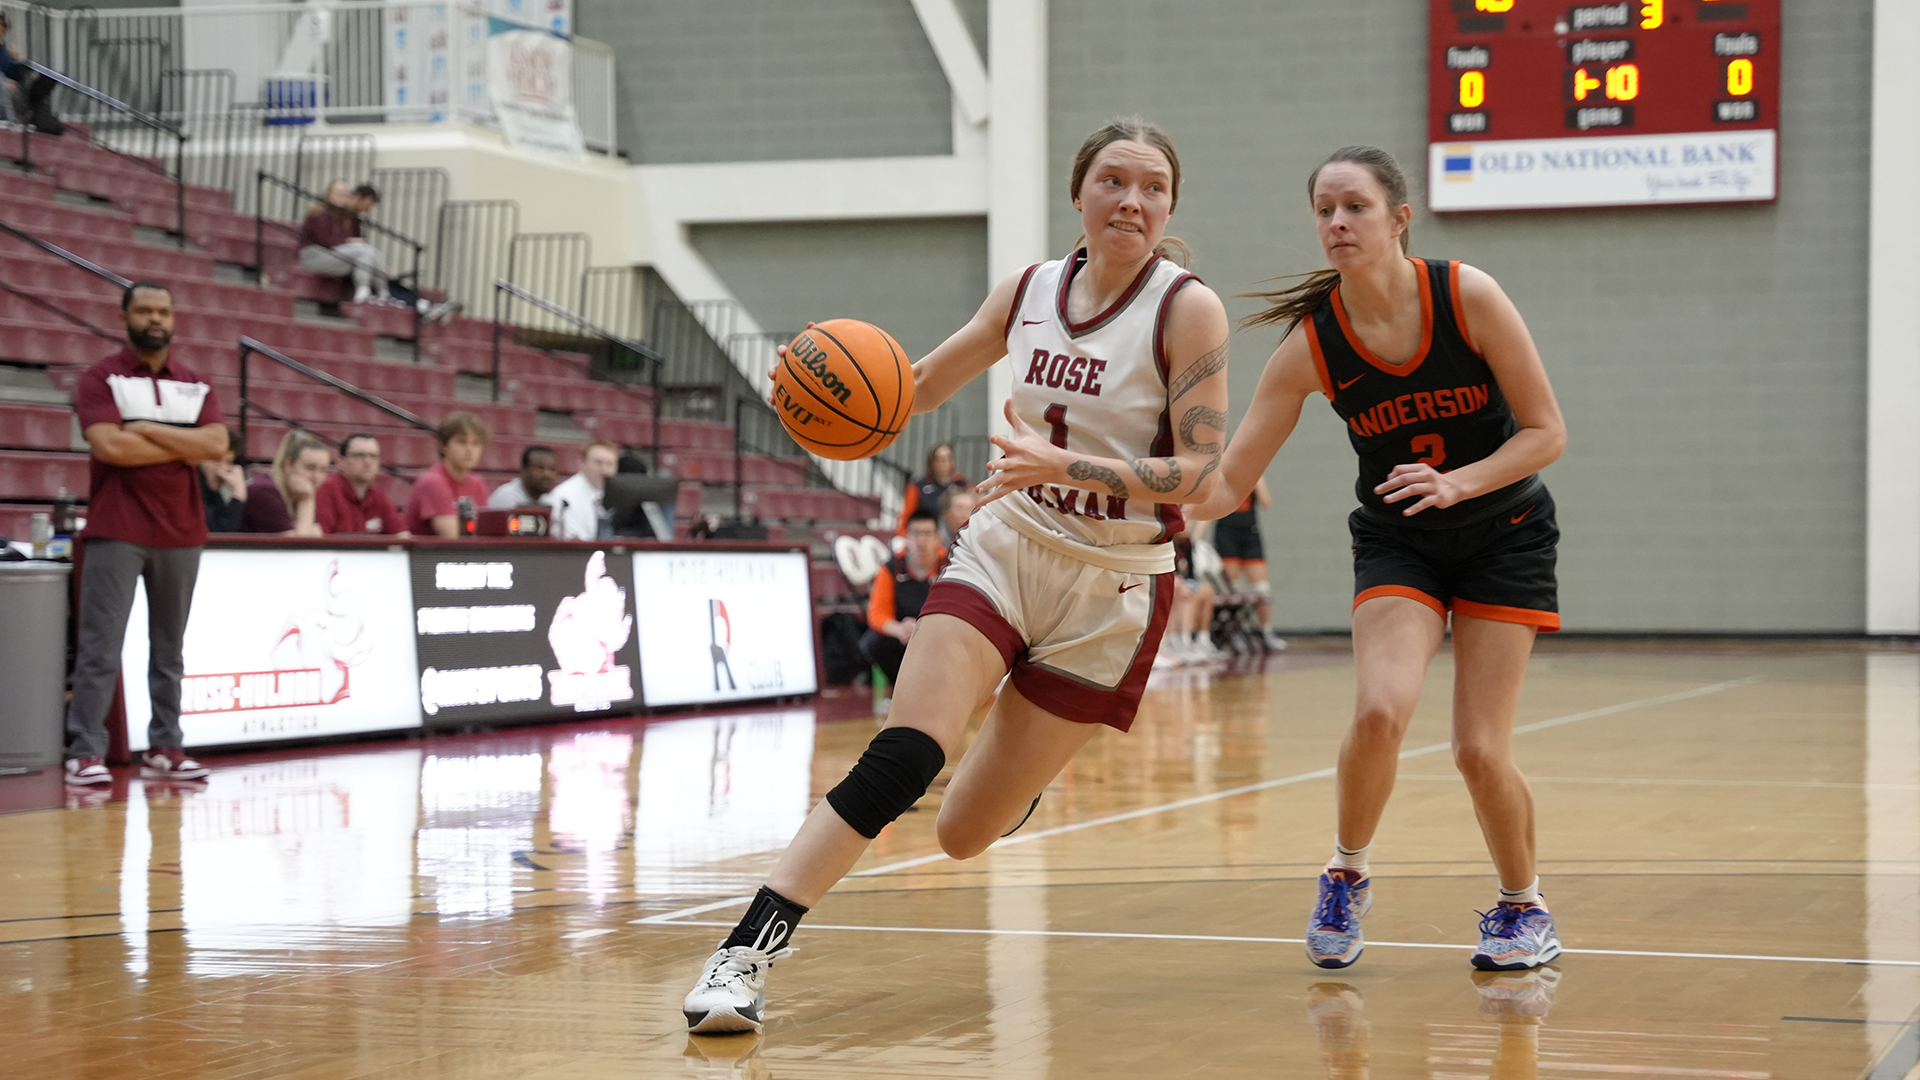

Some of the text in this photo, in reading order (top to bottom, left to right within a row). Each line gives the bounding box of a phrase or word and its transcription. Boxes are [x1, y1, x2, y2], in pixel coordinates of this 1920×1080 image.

[1573, 4, 1629, 31] period
[1572, 39, 1630, 65] player
[1459, 71, 1485, 108] 0
[1727, 58, 1753, 96] 0
[1480, 142, 1756, 173] OLD NATIONAL BANK
[791, 333, 852, 406] Wilson
[1024, 348, 1108, 397] ROSE
[1043, 402, 1069, 450] 1
[1350, 383, 1489, 437] ANDERSON
